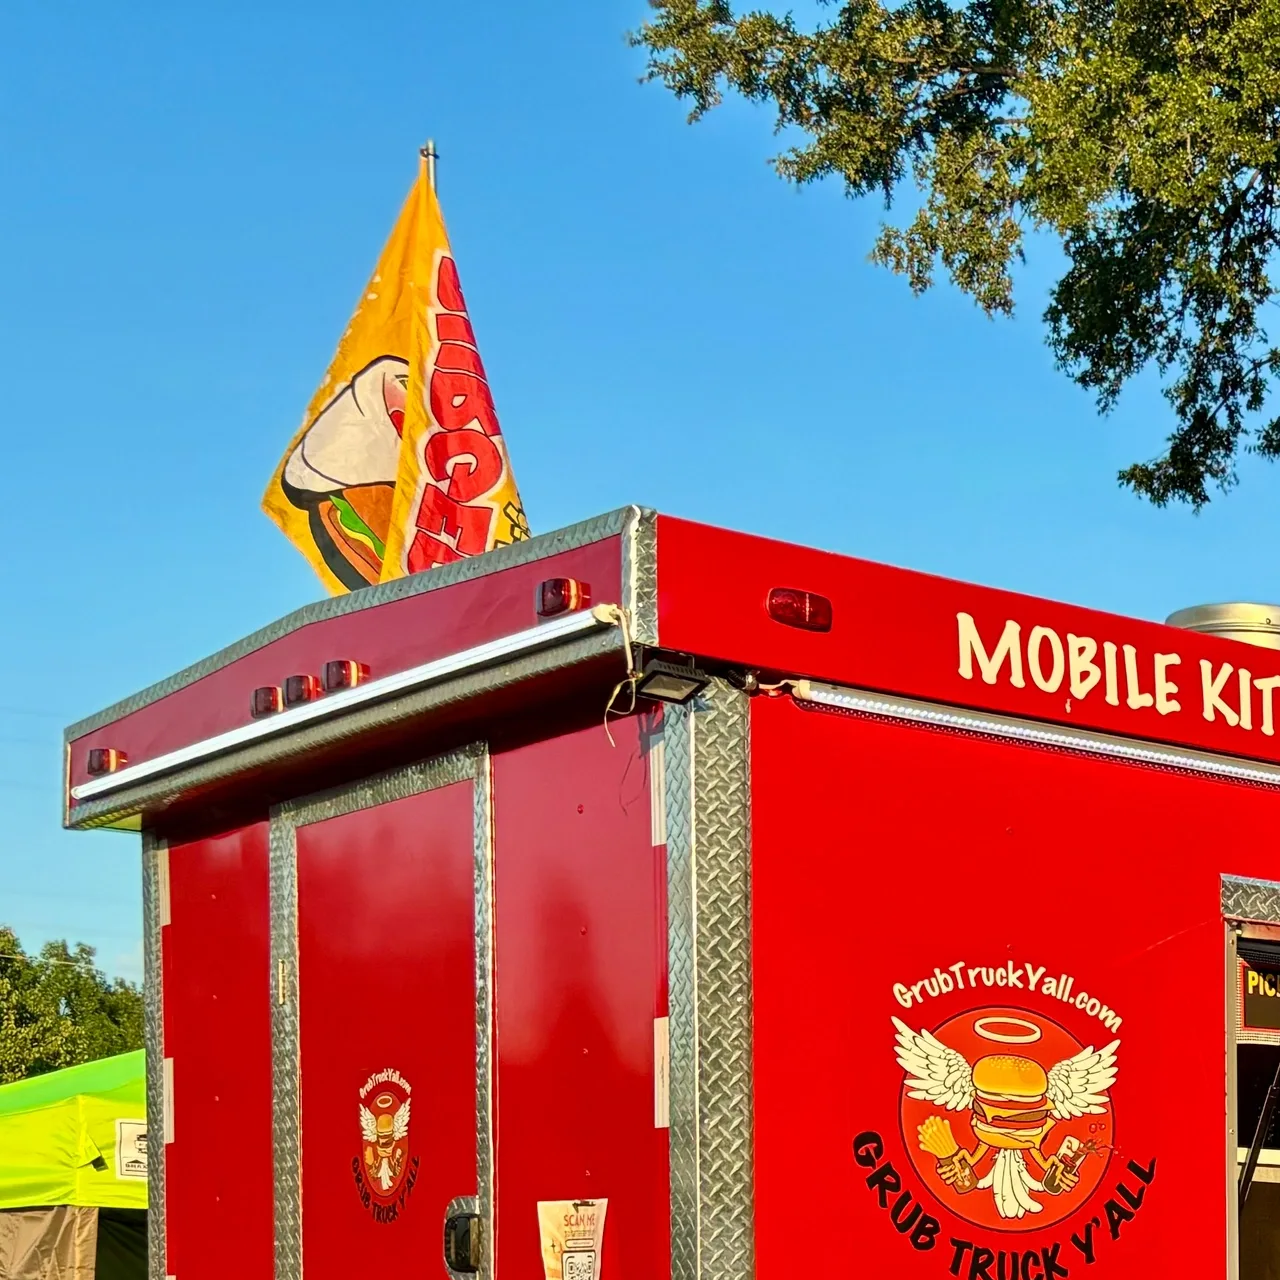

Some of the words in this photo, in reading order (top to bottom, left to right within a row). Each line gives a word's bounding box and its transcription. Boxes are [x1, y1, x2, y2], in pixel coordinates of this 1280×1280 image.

[957, 612, 1181, 714] MOBILE
[892, 960, 1123, 1033] GrubTruckYall.com
[853, 1131, 940, 1252] GRUB
[1071, 1157, 1157, 1265] Y'ALL
